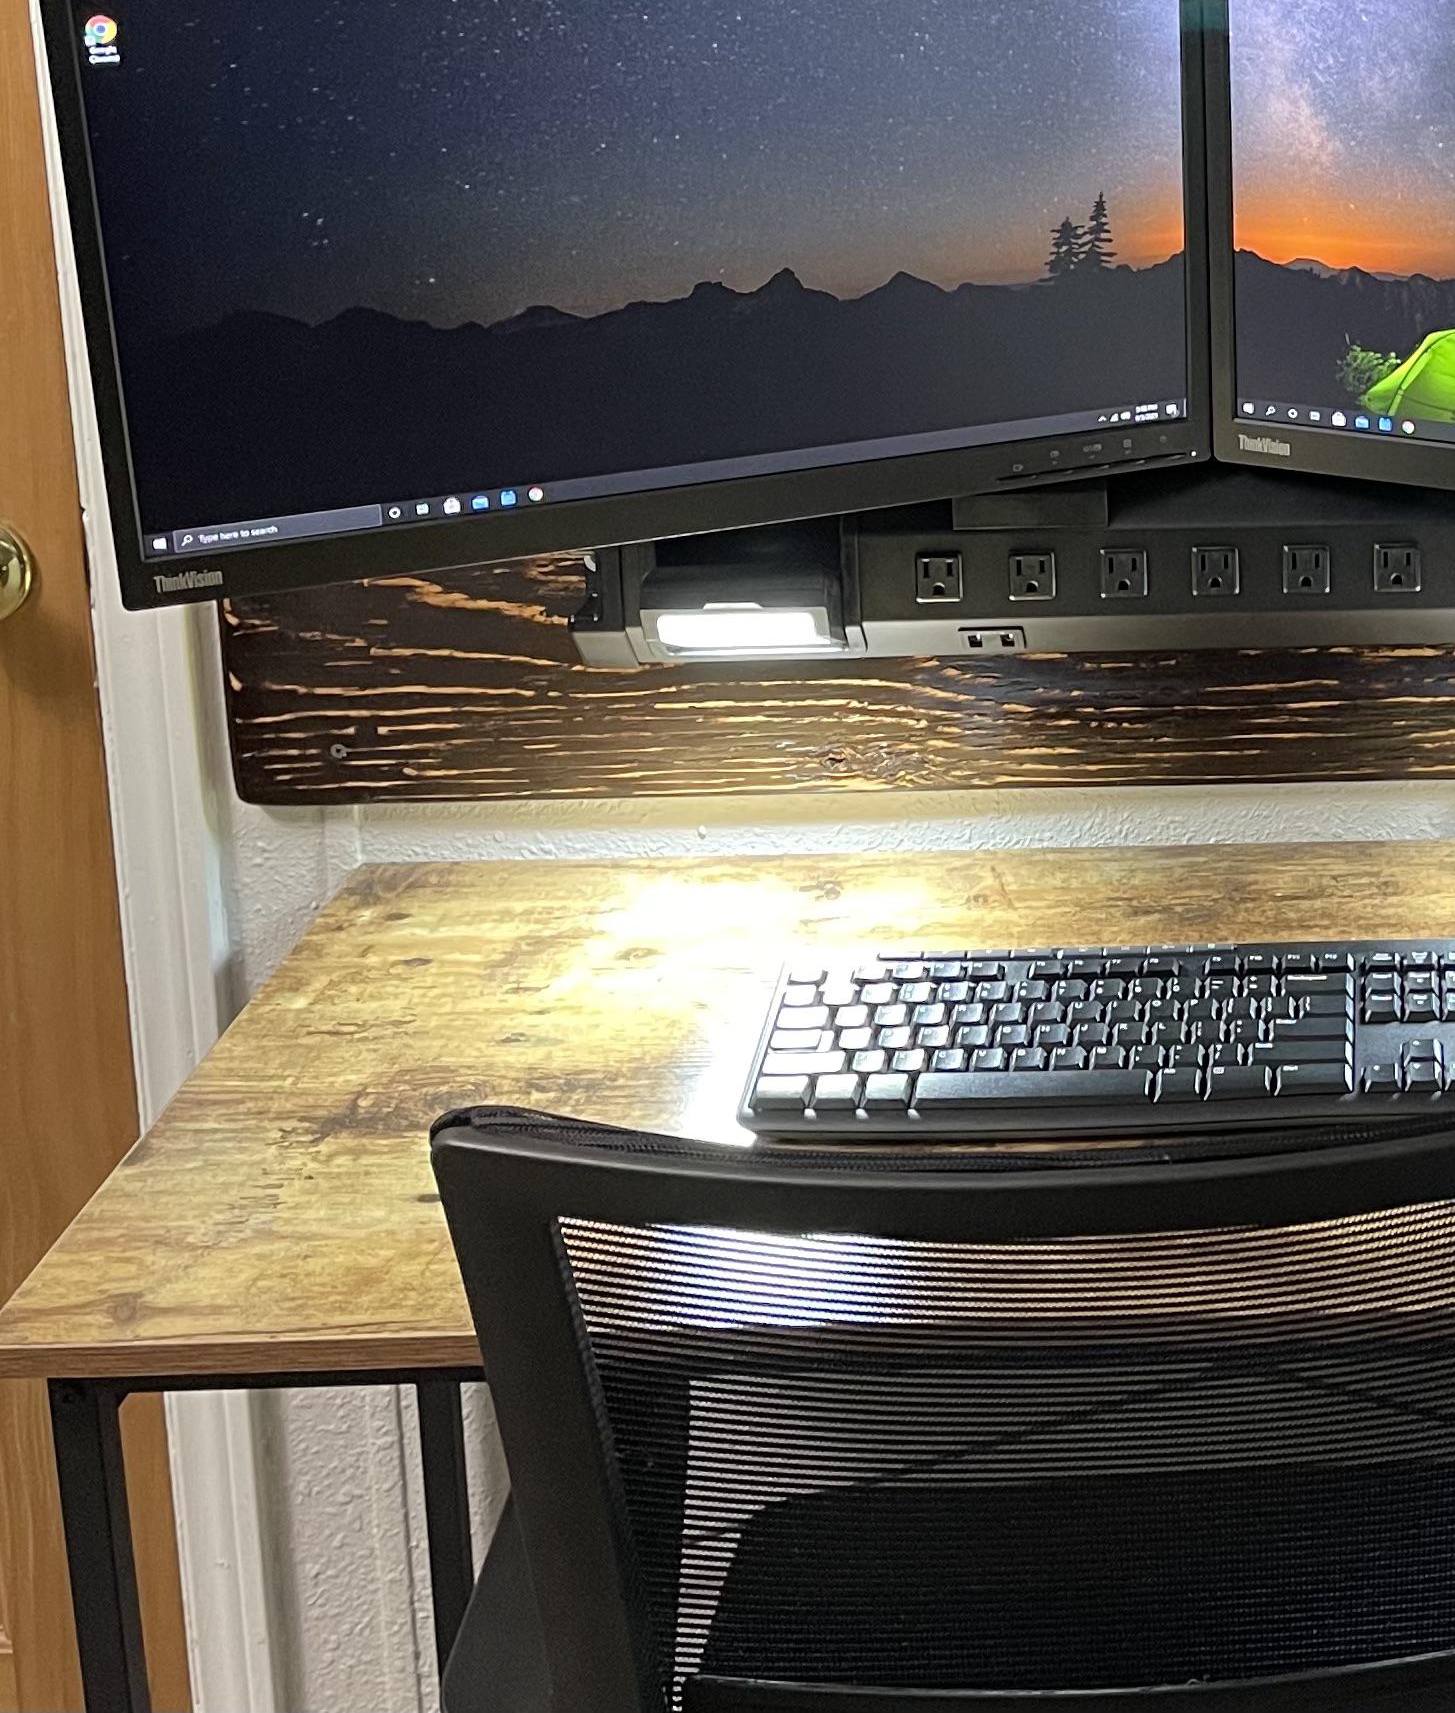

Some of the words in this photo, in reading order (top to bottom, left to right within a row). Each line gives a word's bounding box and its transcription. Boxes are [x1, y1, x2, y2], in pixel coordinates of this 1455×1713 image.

[197, 533, 219, 544] Type
[219, 530, 239, 541] here
[239, 529, 250, 538] to
[250, 525, 279, 536] search
[153, 569, 224, 594] ThinkVision
